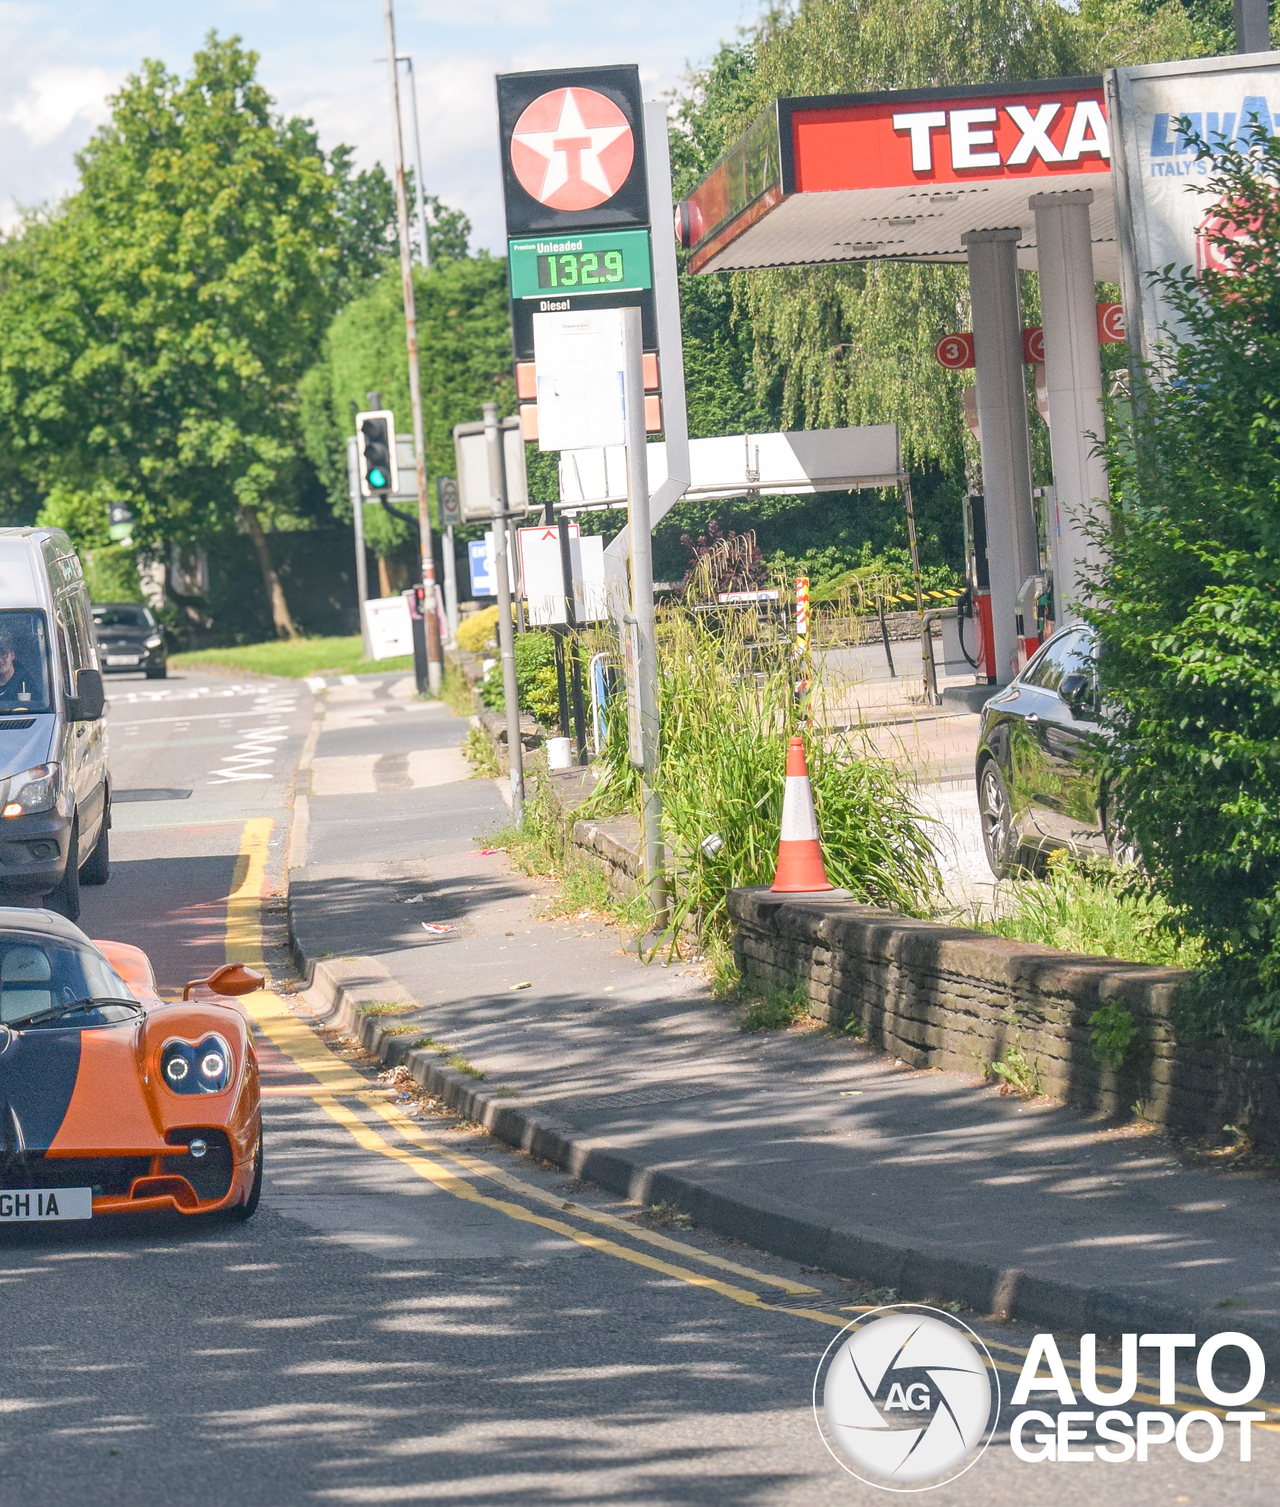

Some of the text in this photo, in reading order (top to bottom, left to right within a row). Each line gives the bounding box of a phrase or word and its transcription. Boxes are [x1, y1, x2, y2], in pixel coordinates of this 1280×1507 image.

[1150, 95, 1280, 157] LAVA
[893, 100, 1110, 172] TEXA
[1150, 160, 1207, 177] ITALY'S
[537, 239, 583, 253] Unleaded
[547, 251, 623, 287] 132.9
[540, 299, 570, 312] Diesel
[946, 343, 959, 360] 3
